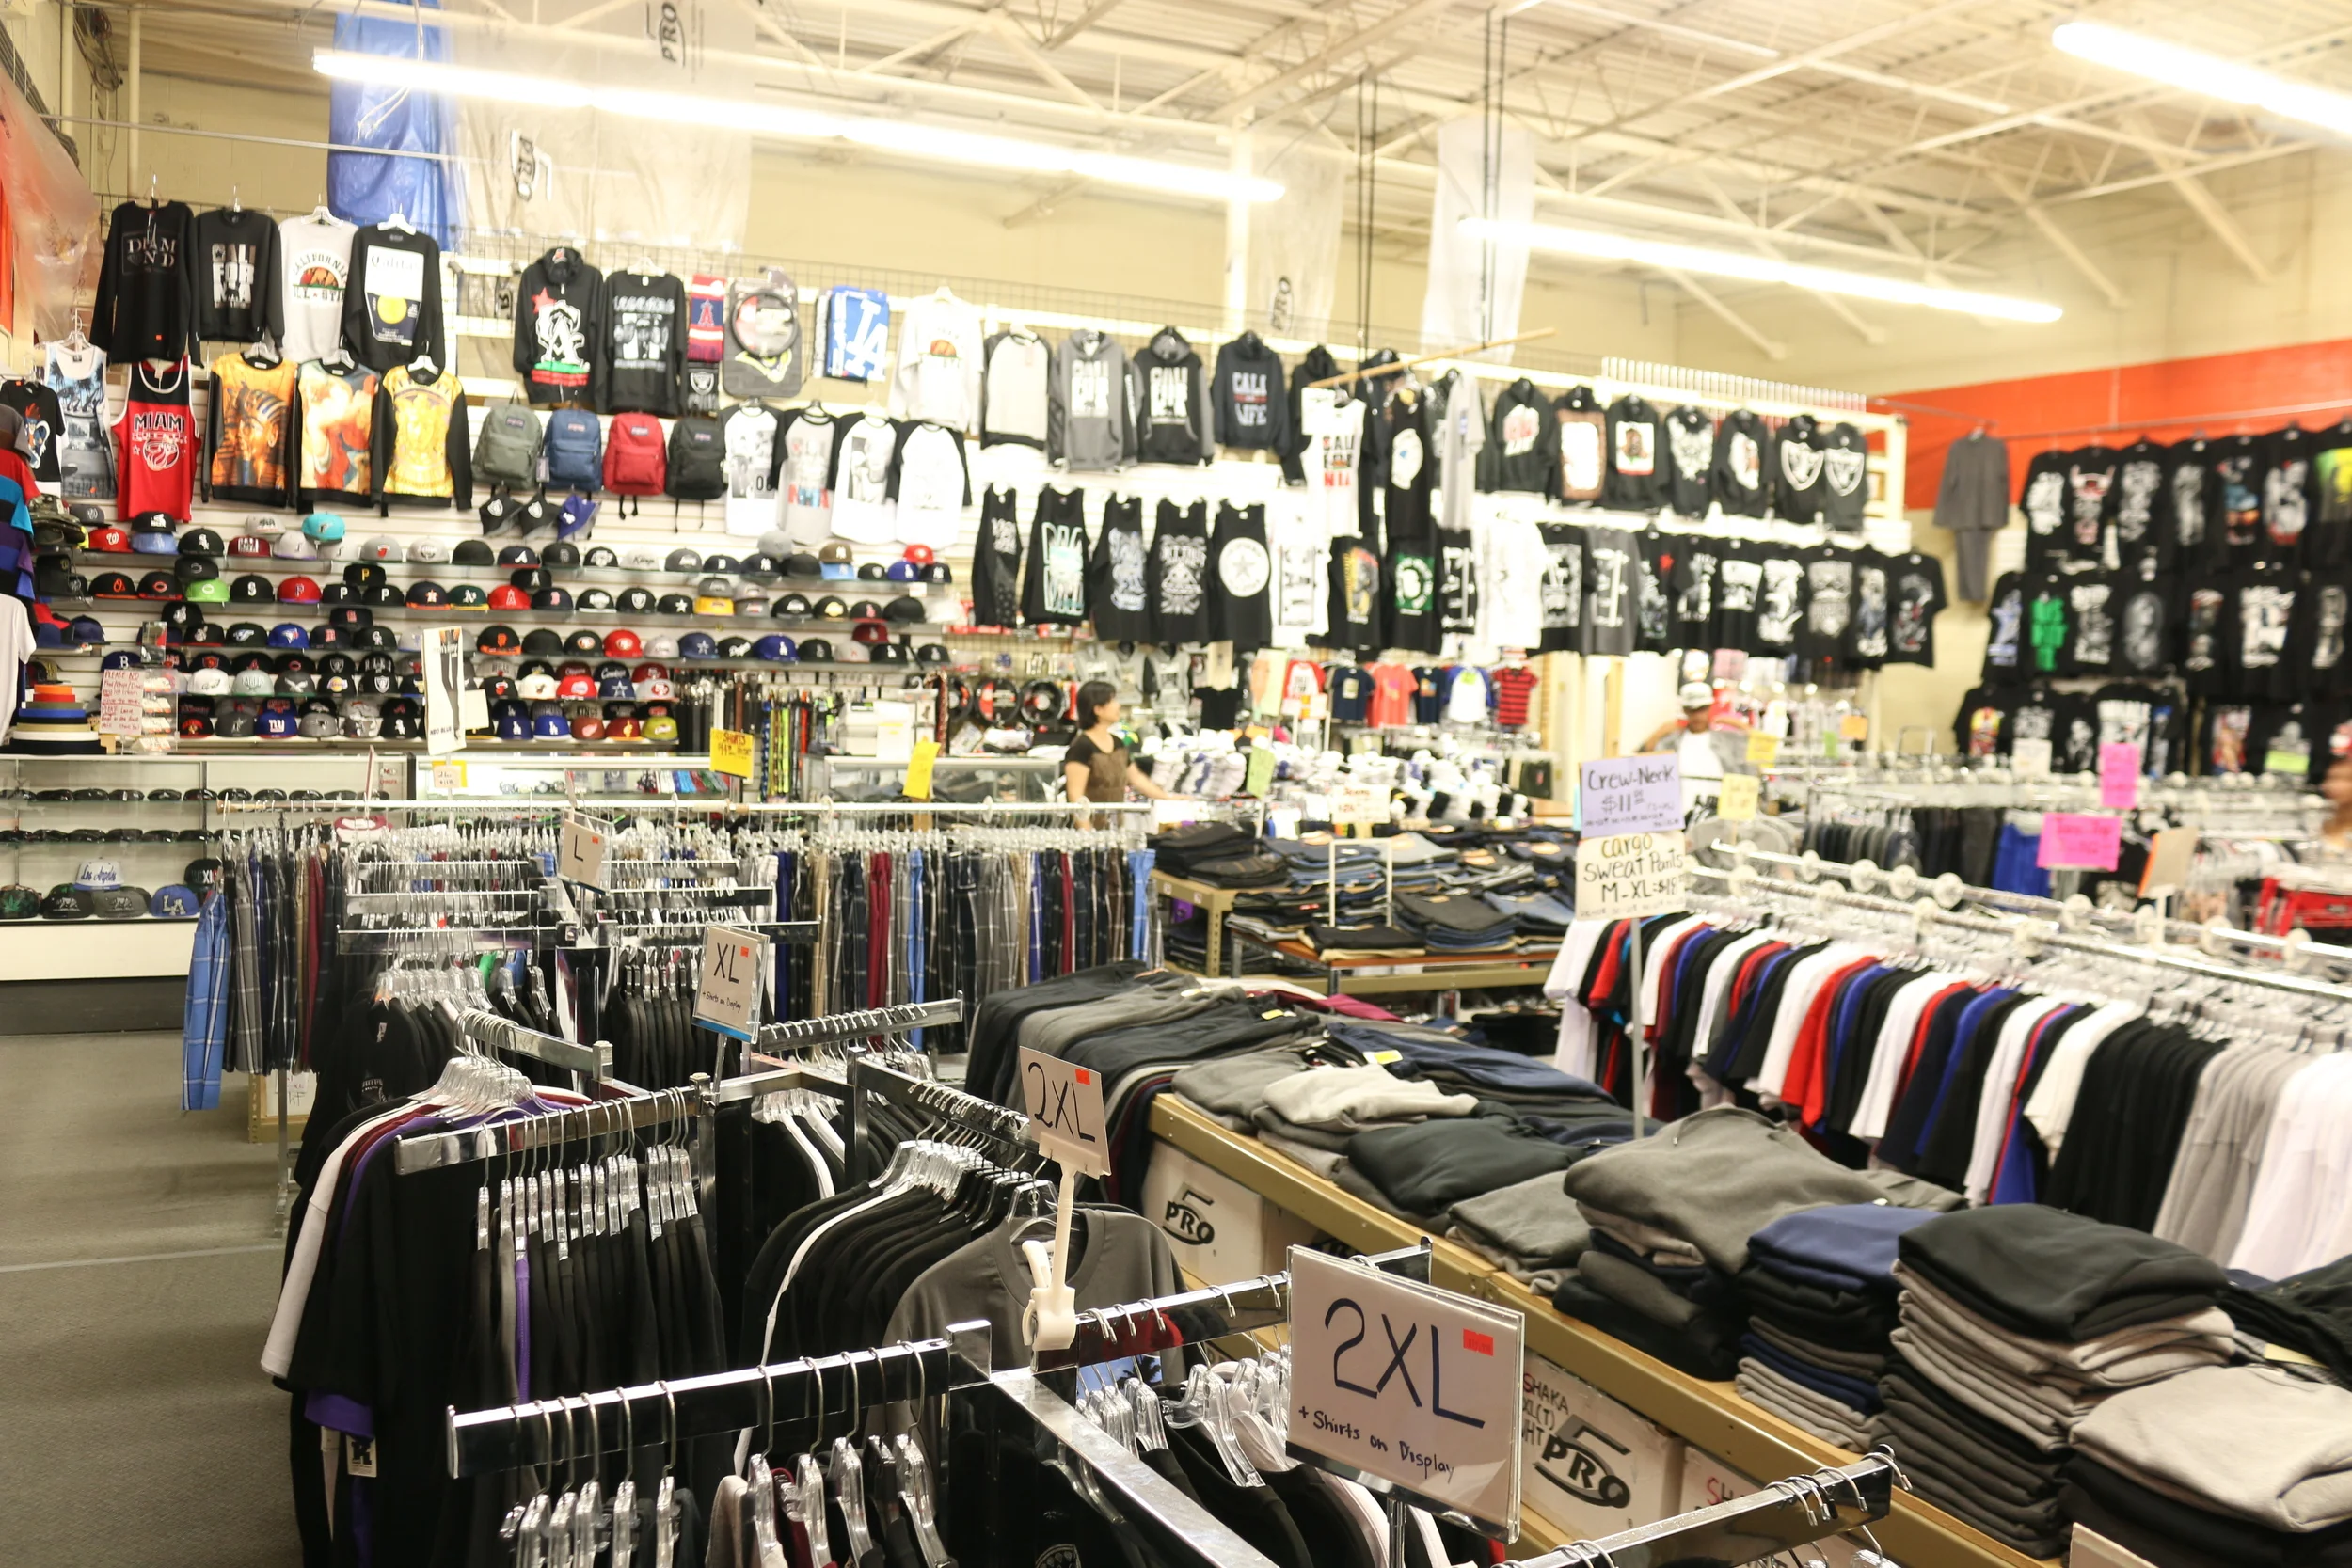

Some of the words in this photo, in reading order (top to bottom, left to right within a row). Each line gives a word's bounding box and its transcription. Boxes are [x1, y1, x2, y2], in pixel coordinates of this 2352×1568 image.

[135, 410, 185, 433] MIAMI
[574, 834, 584, 862] L
[162, 895, 187, 916] LA
[713, 942, 739, 984] XL
[1027, 1061, 1096, 1143] 2XL
[1164, 1200, 1216, 1245] PRO
[1324, 1297, 1486, 1430] 2XL
[1522, 1372, 1569, 1416] SHAKA
[1312, 1410, 1360, 1440] Shirts
[1370, 1434, 1389, 1452] on
[1398, 1439, 1455, 1484] Display
[1541, 1433, 1631, 1509] PRO
